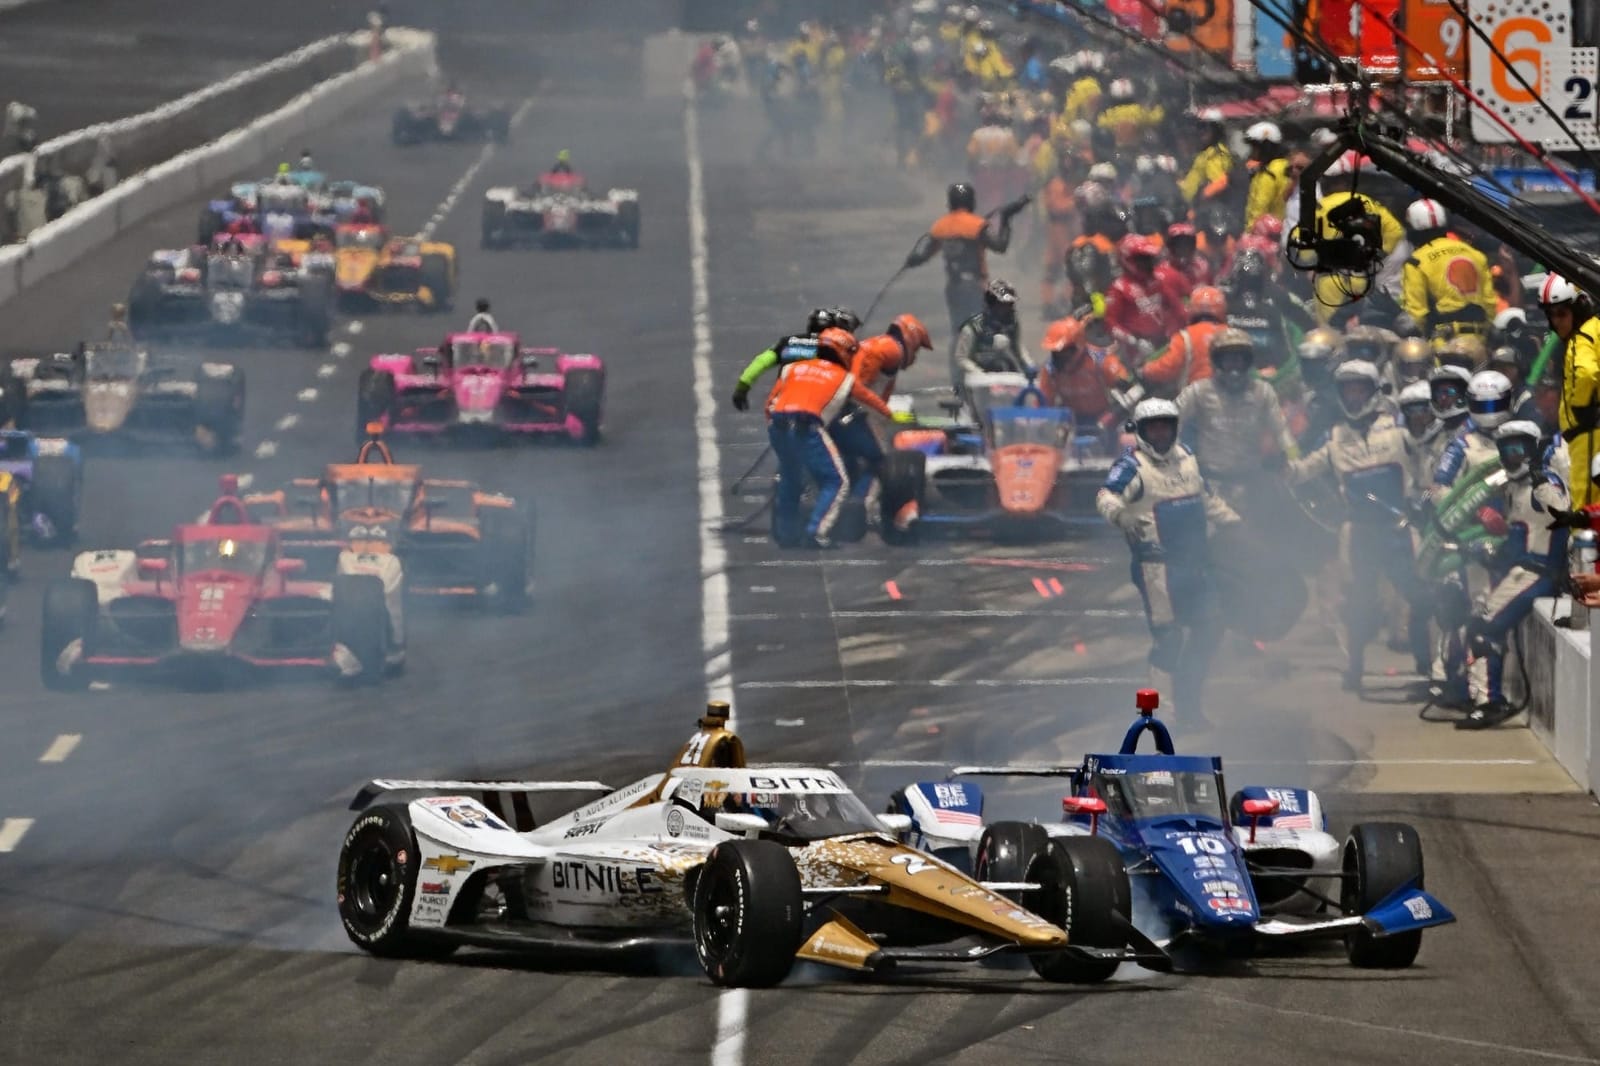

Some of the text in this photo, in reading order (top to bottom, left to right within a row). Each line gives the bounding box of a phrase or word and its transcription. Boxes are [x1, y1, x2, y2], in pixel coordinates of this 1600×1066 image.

[1440, 18, 1462, 58] 9
[1490, 16, 1552, 104] 6
[1564, 76, 1592, 119] 2
[680, 732, 711, 765] 21
[1176, 837, 1226, 855] 10
[553, 861, 663, 894] BITNILE
